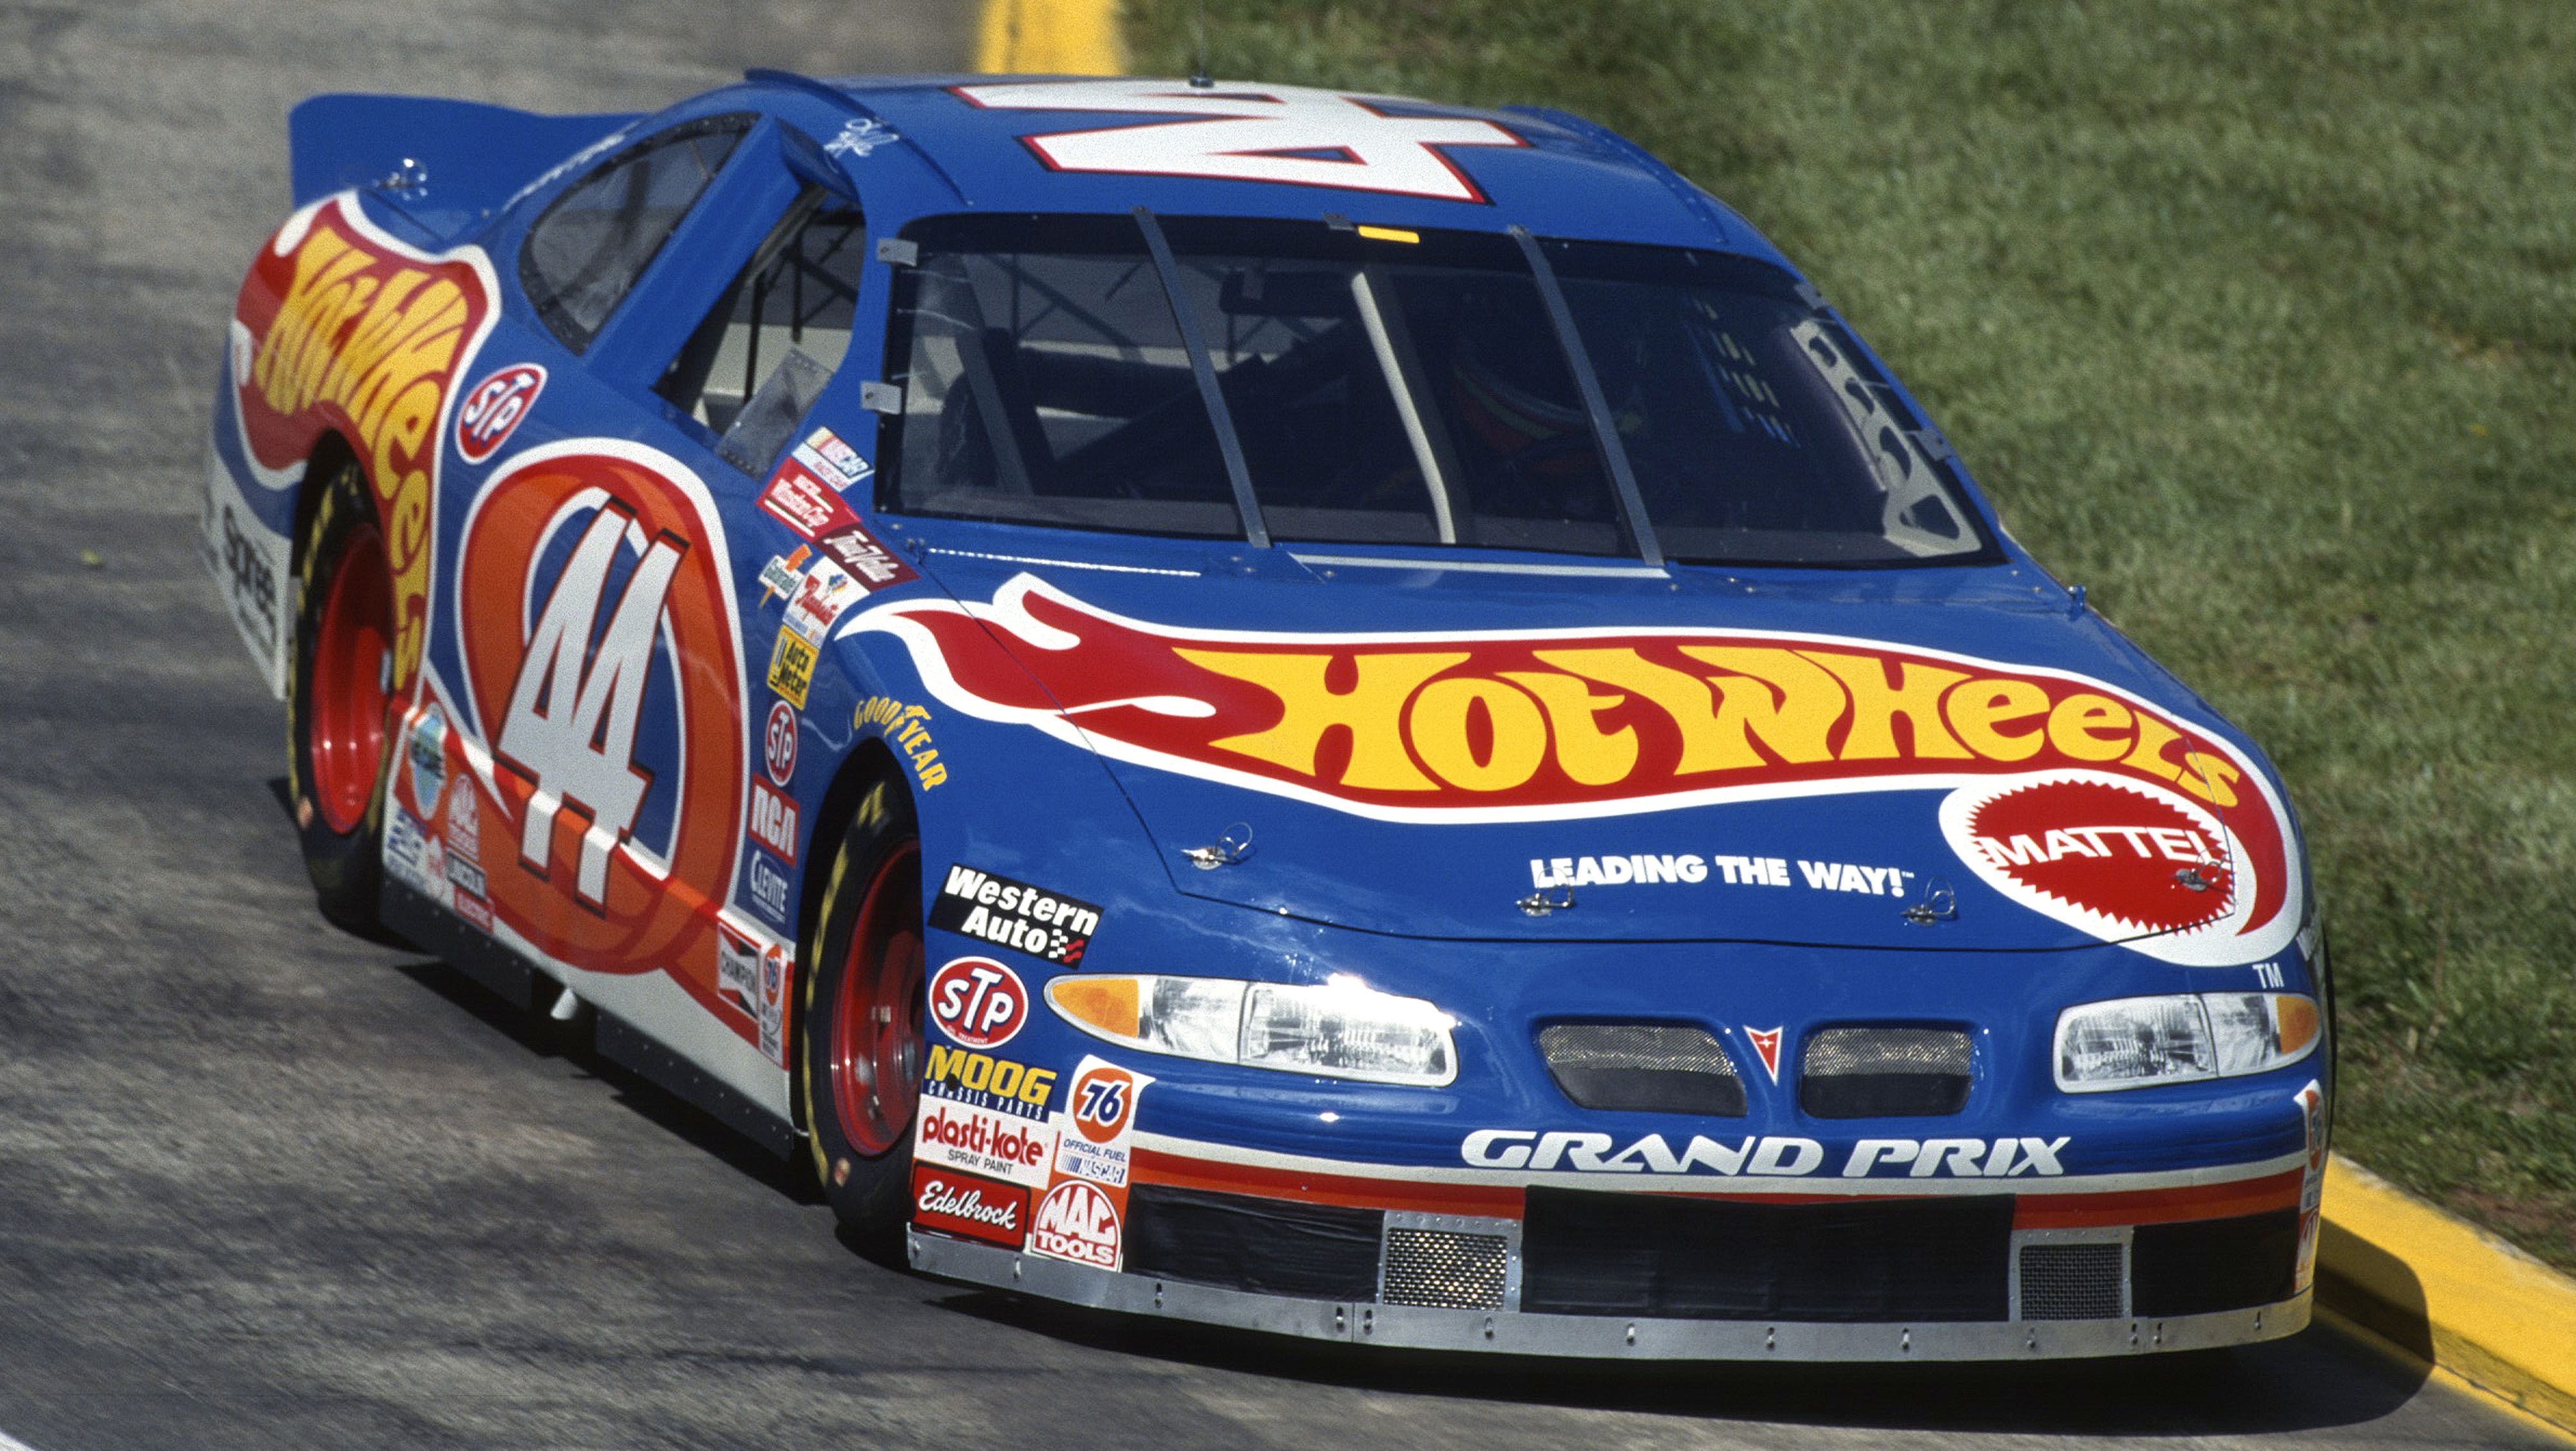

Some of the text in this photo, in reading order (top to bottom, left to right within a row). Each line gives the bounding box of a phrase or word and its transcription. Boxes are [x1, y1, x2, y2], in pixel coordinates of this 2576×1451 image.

[942, 79, 1535, 205] 44
[463, 372, 536, 444] STP
[784, 643, 810, 671] Auto
[493, 495, 690, 919] 44
[768, 711, 793, 769] STP
[752, 784, 796, 857] RCA
[1530, 855, 1707, 888] LEADING
[1716, 855, 1790, 886] THE
[1975, 826, 2231, 871] MATTEL
[750, 849, 788, 913] CLEVITE
[945, 866, 1099, 936] Western
[961, 906, 1048, 953] Auto
[937, 967, 1014, 1032] STP
[2252, 963, 2285, 989] TM
[925, 1044, 1057, 1106] MOOG
[997, 1096, 1043, 1120] PARTS
[1079, 1080, 1127, 1125] 76
[922, 1106, 1043, 1166] plasti-kote
[1063, 1139, 1127, 1162] OFFICIAL FUEL
[1461, 1129, 2071, 1178] GRAND PRIX
[947, 1149, 1014, 1175] SPRAY PAINT
[918, 1180, 1018, 1231] Edelbrock
[1039, 1186, 1115, 1246] MAC
[1037, 1229, 1114, 1264] TOOLS
